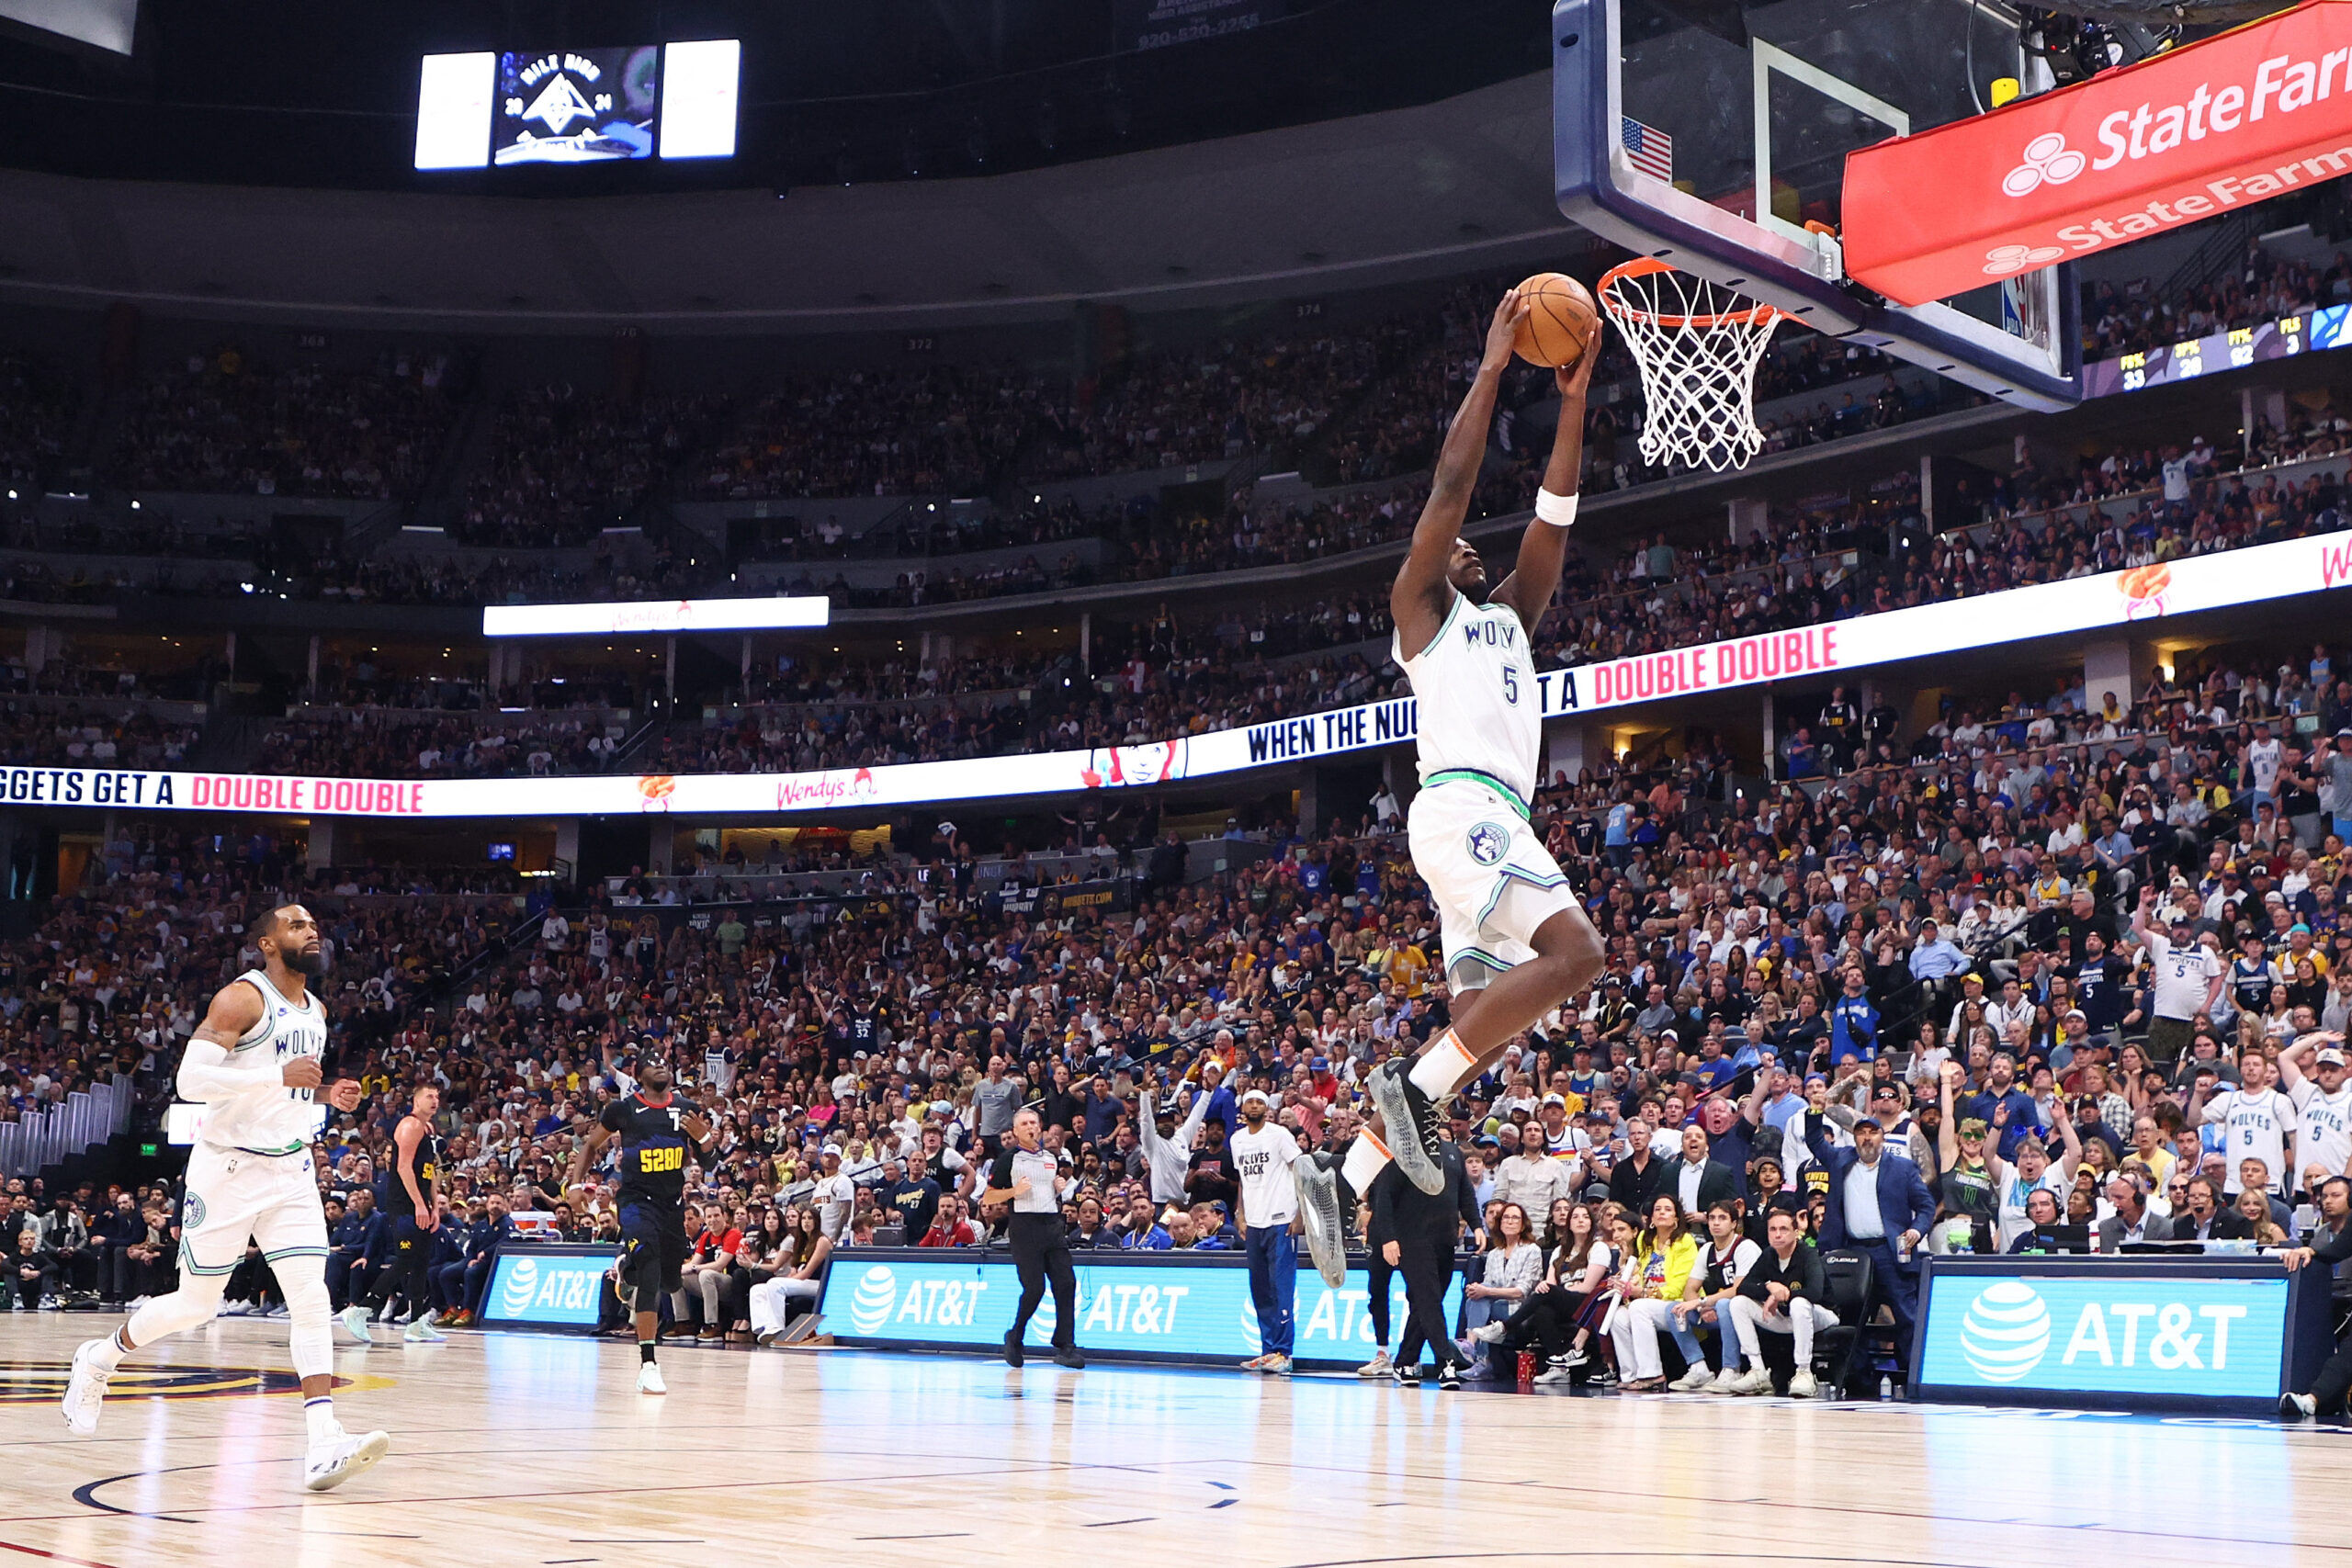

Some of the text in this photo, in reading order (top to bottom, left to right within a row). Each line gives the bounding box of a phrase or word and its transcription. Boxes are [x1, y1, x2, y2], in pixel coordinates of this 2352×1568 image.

[2092, 46, 2352, 171] StateFar
[2122, 369, 2145, 390] 33
[2286, 335, 2301, 355] 3
[1248, 717, 1316, 762] WHEN
[1322, 708, 1367, 750] THE
[1560, 671, 1578, 711] A
[1594, 661, 1707, 705] DOUBLE
[1716, 625, 1839, 686] DOUBLE
[1501, 663, 1521, 706] 5
[92, 773, 147, 804] GET
[155, 774, 175, 805] A
[191, 775, 304, 809] DOUBLE
[313, 779, 424, 813] DOUBLE
[777, 770, 845, 810] Wendy's
[2167, 955, 2200, 969] WOLVES
[2175, 964, 2187, 978] 5
[2085, 984, 2094, 998] 5
[856, 1028, 870, 1039] 32
[669, 1111, 681, 1132] 7
[2231, 1113, 2271, 1132] WOLVES
[2306, 1110, 2343, 1132] WOLVES
[2244, 1130, 2253, 1145] 5
[2312, 1126, 2322, 1142] 5
[639, 1146, 684, 1173] 5280
[1238, 1152, 1270, 1166] WOLVES
[1243, 1164, 1264, 1177] BACK
[536, 1270, 603, 1309] AT&T
[896, 1280, 989, 1325] AT&T
[1083, 1284, 1189, 1335] AT&T
[2061, 1302, 2247, 1370] AT&T
